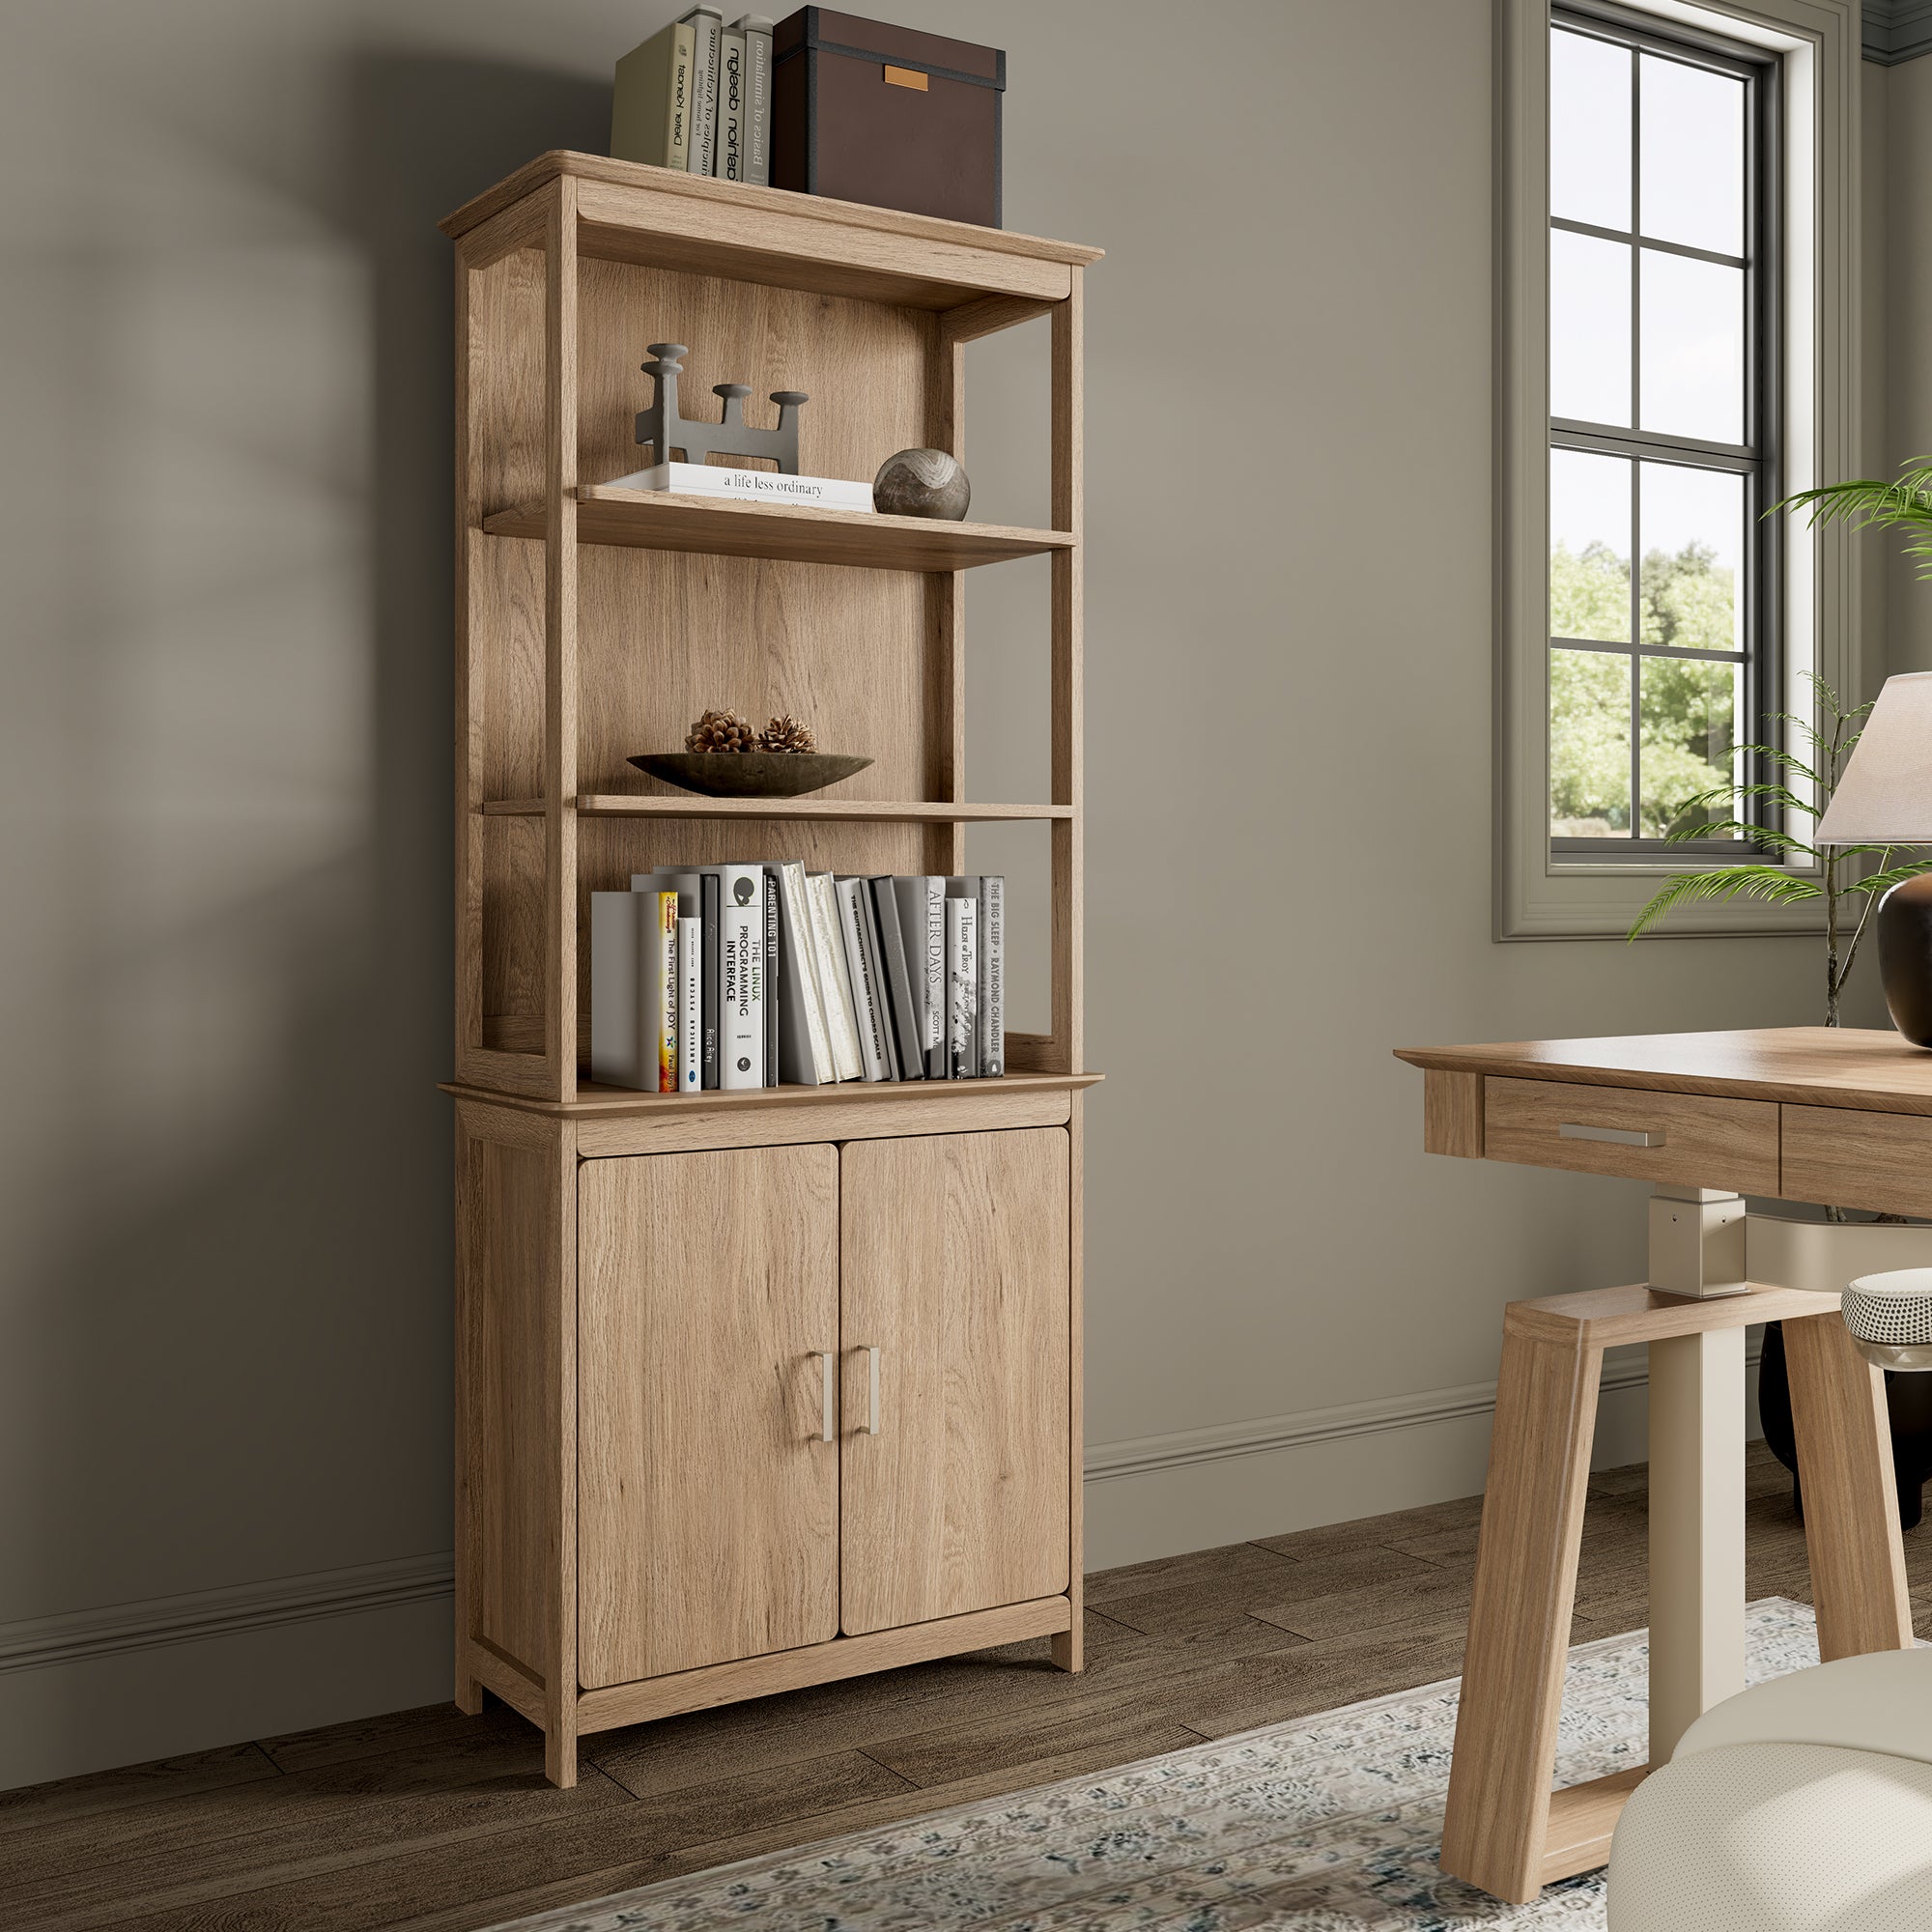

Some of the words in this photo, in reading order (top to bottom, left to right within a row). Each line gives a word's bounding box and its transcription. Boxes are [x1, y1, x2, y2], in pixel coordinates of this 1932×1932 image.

[724, 476, 730, 486] a
[734, 474, 752, 489] life
[754, 475, 774, 491] less
[777, 479, 823, 497] ordinary
[767, 881, 776, 937] PARENTING
[929, 891, 941, 942] AFTER
[990, 903, 999, 919] BIG
[767, 940, 776, 957] 101
[990, 922, 1000, 946] SLEEP
[752, 939, 760, 963] THE
[929, 945, 941, 983] DAYS
[726, 940, 736, 1002] INTERFACE
[739, 925, 749, 1016] PROGRAMMING
[752, 966, 760, 1002] LINUX
[990, 957, 1000, 1003] RAYMOND
[667, 977, 675, 998] Light
[668, 1001, 675, 1009] of
[667, 1011, 675, 1030] JOY
[990, 1006, 1000, 1053] CHANDLER
